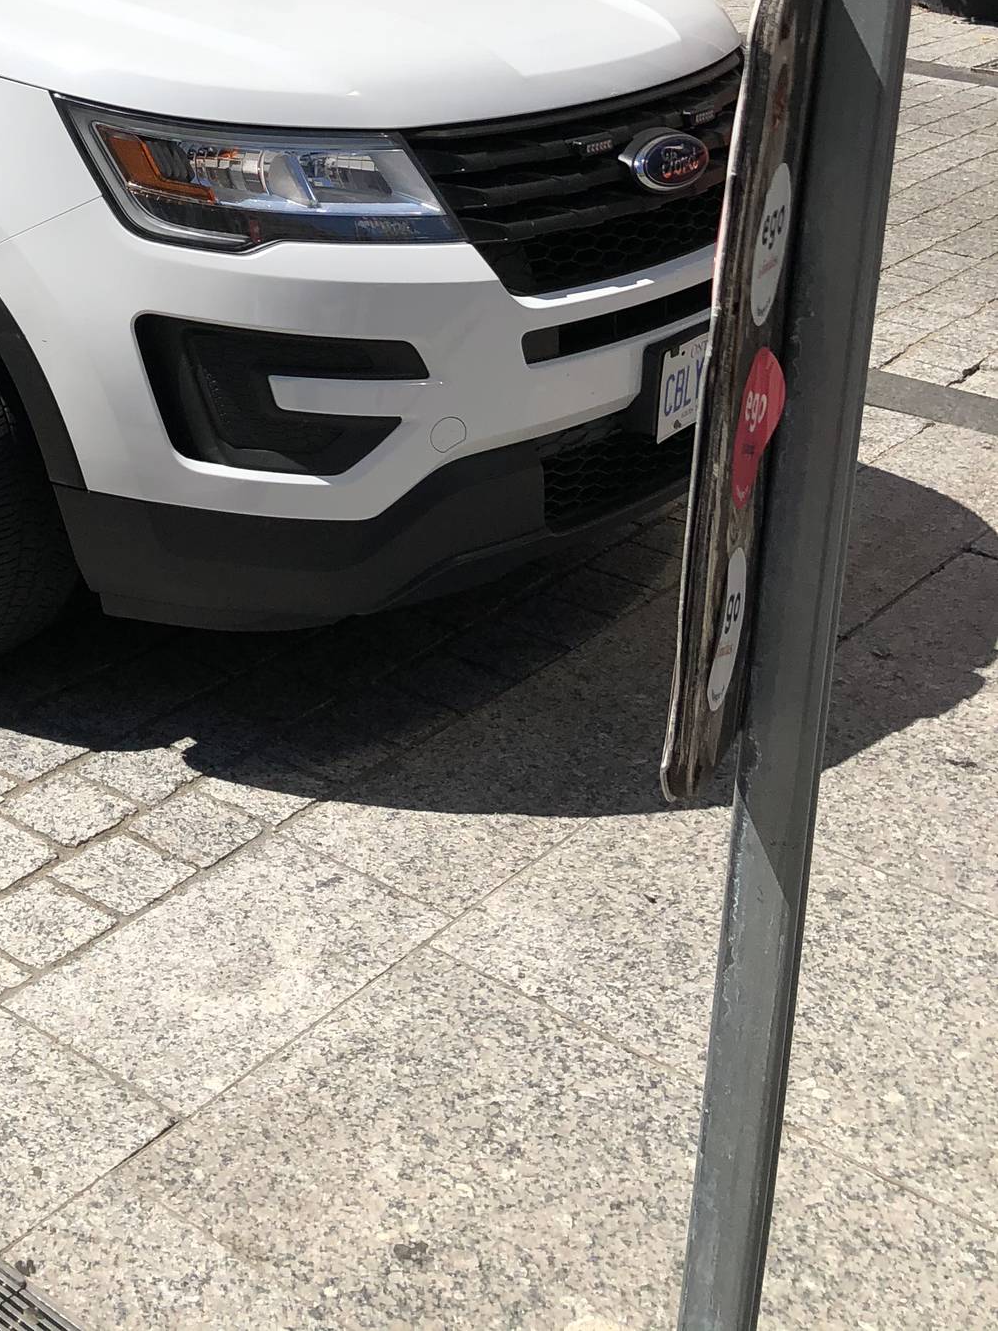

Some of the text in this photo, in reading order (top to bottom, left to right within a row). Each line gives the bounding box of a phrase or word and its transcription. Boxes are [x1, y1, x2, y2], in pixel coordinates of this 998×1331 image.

[661, 143, 700, 179] Ford
[762, 205, 785, 250] ego
[745, 390, 767, 433] ego
